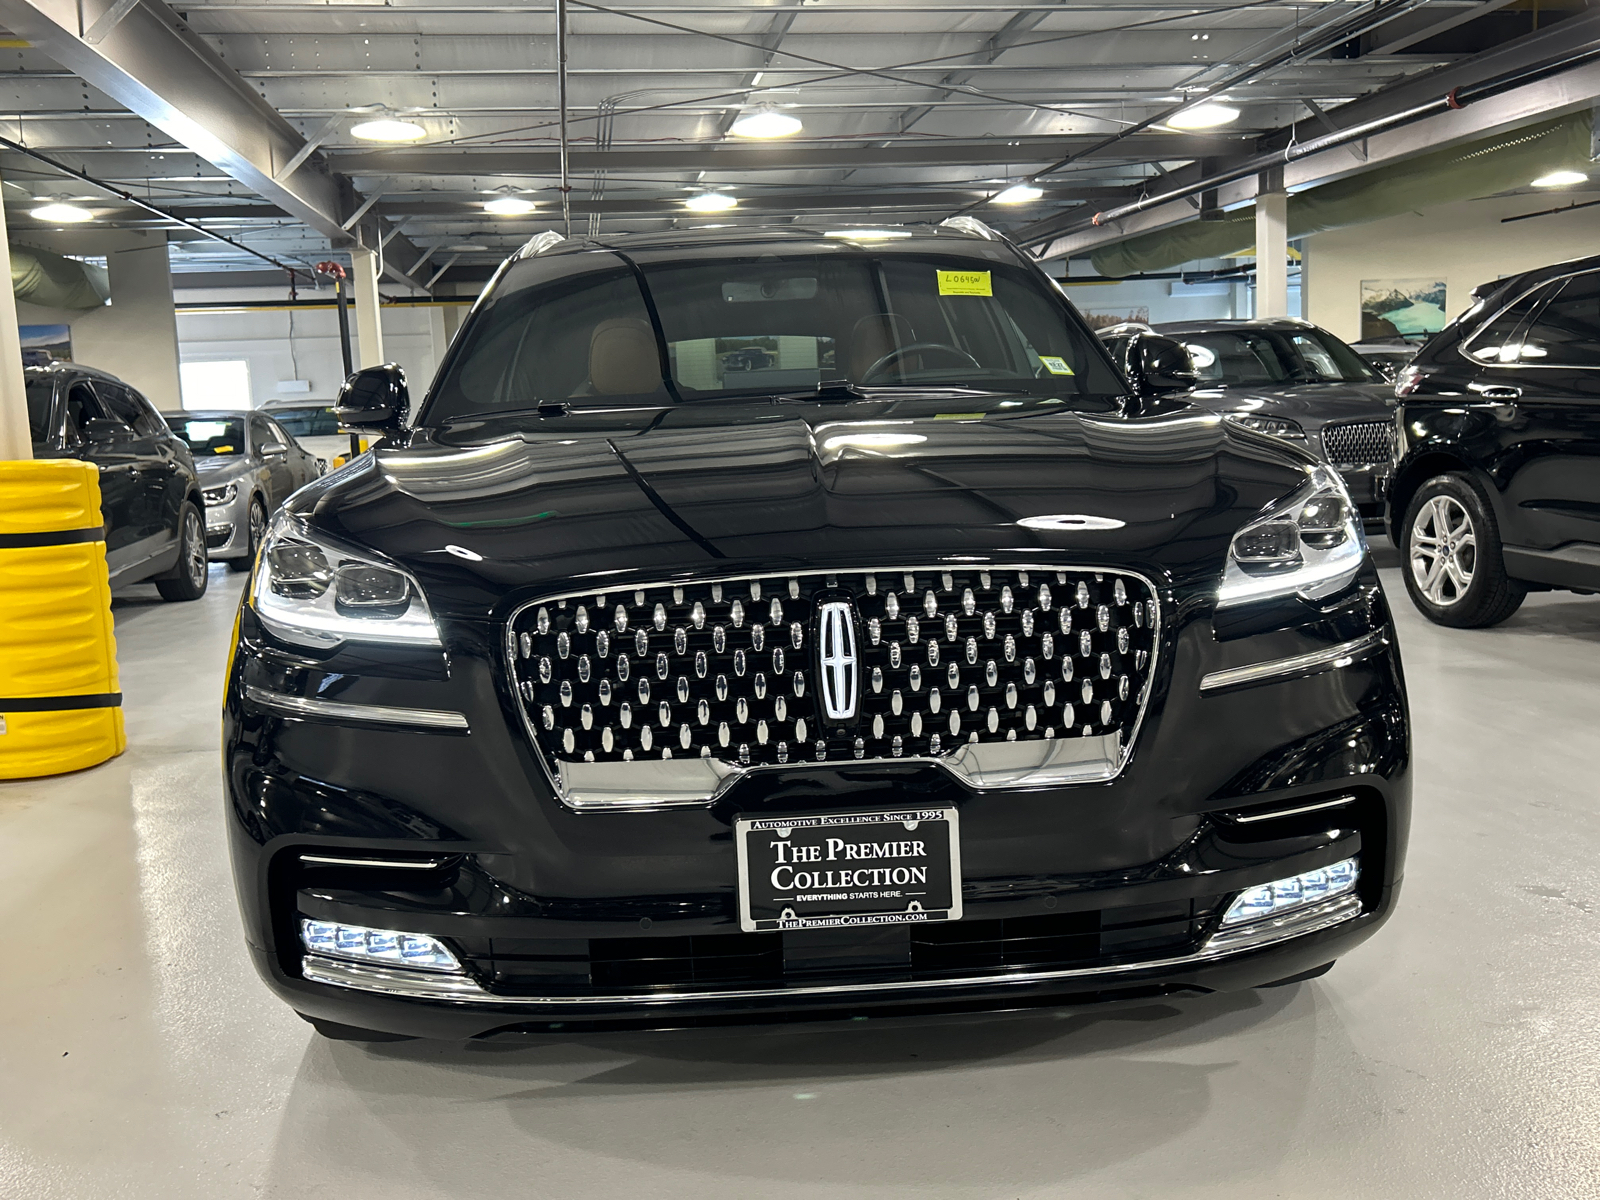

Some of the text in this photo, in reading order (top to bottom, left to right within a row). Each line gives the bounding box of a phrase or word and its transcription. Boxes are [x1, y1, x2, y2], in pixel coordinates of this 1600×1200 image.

[916, 811, 943, 820] 1995
[796, 893, 848, 902] EVERYTHING
[849, 892, 879, 900] STARTS
